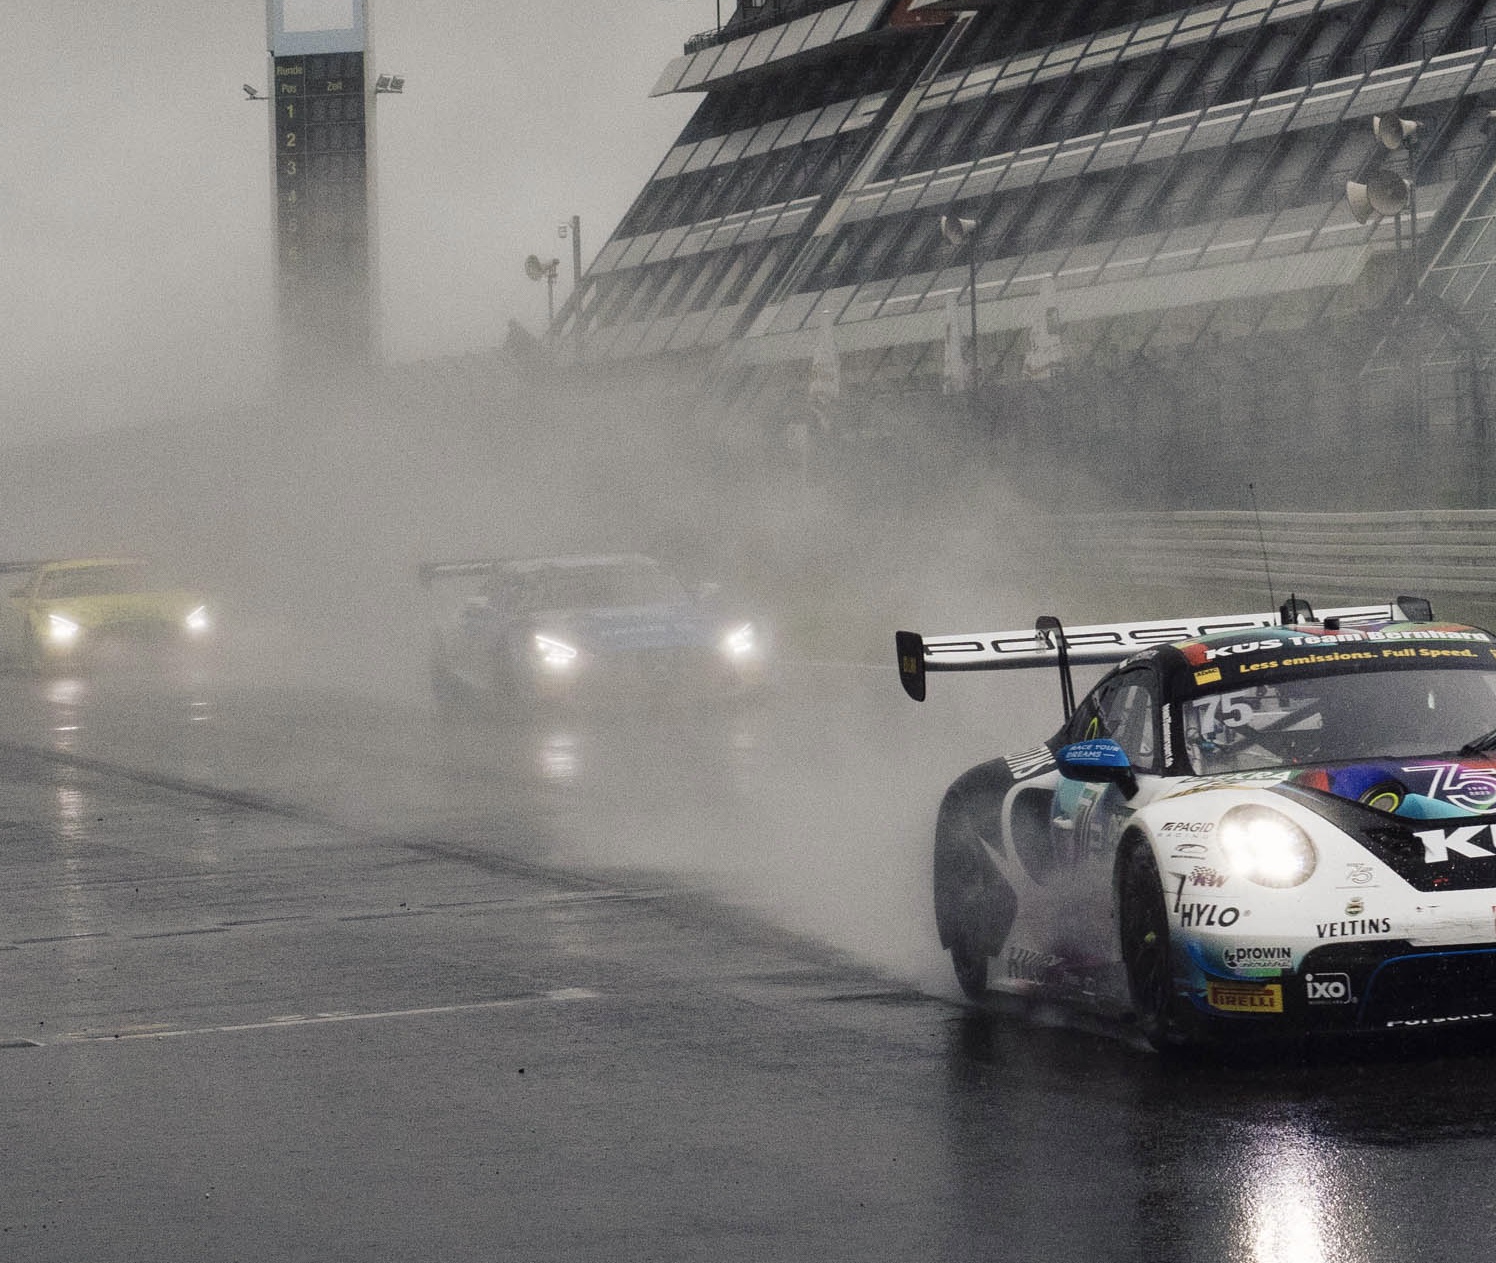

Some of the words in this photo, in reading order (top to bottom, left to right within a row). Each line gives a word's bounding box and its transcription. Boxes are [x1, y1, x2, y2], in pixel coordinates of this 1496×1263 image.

[287, 104, 294, 118] 1
[287, 132, 296, 147] 2
[287, 161, 296, 175] 3
[1288, 634, 1362, 646] Team
[1239, 660, 1278, 673] Less
[1282, 650, 1378, 666] emissions.
[1382, 648, 1417, 657] Full
[1419, 648, 1479, 658] Speed.
[1192, 690, 1253, 735] 75
[1173, 822, 1215, 833] PAGID
[1181, 903, 1241, 928] HYLO
[1316, 917, 1392, 939] VELTINS
[1305, 973, 1346, 999] ixo
